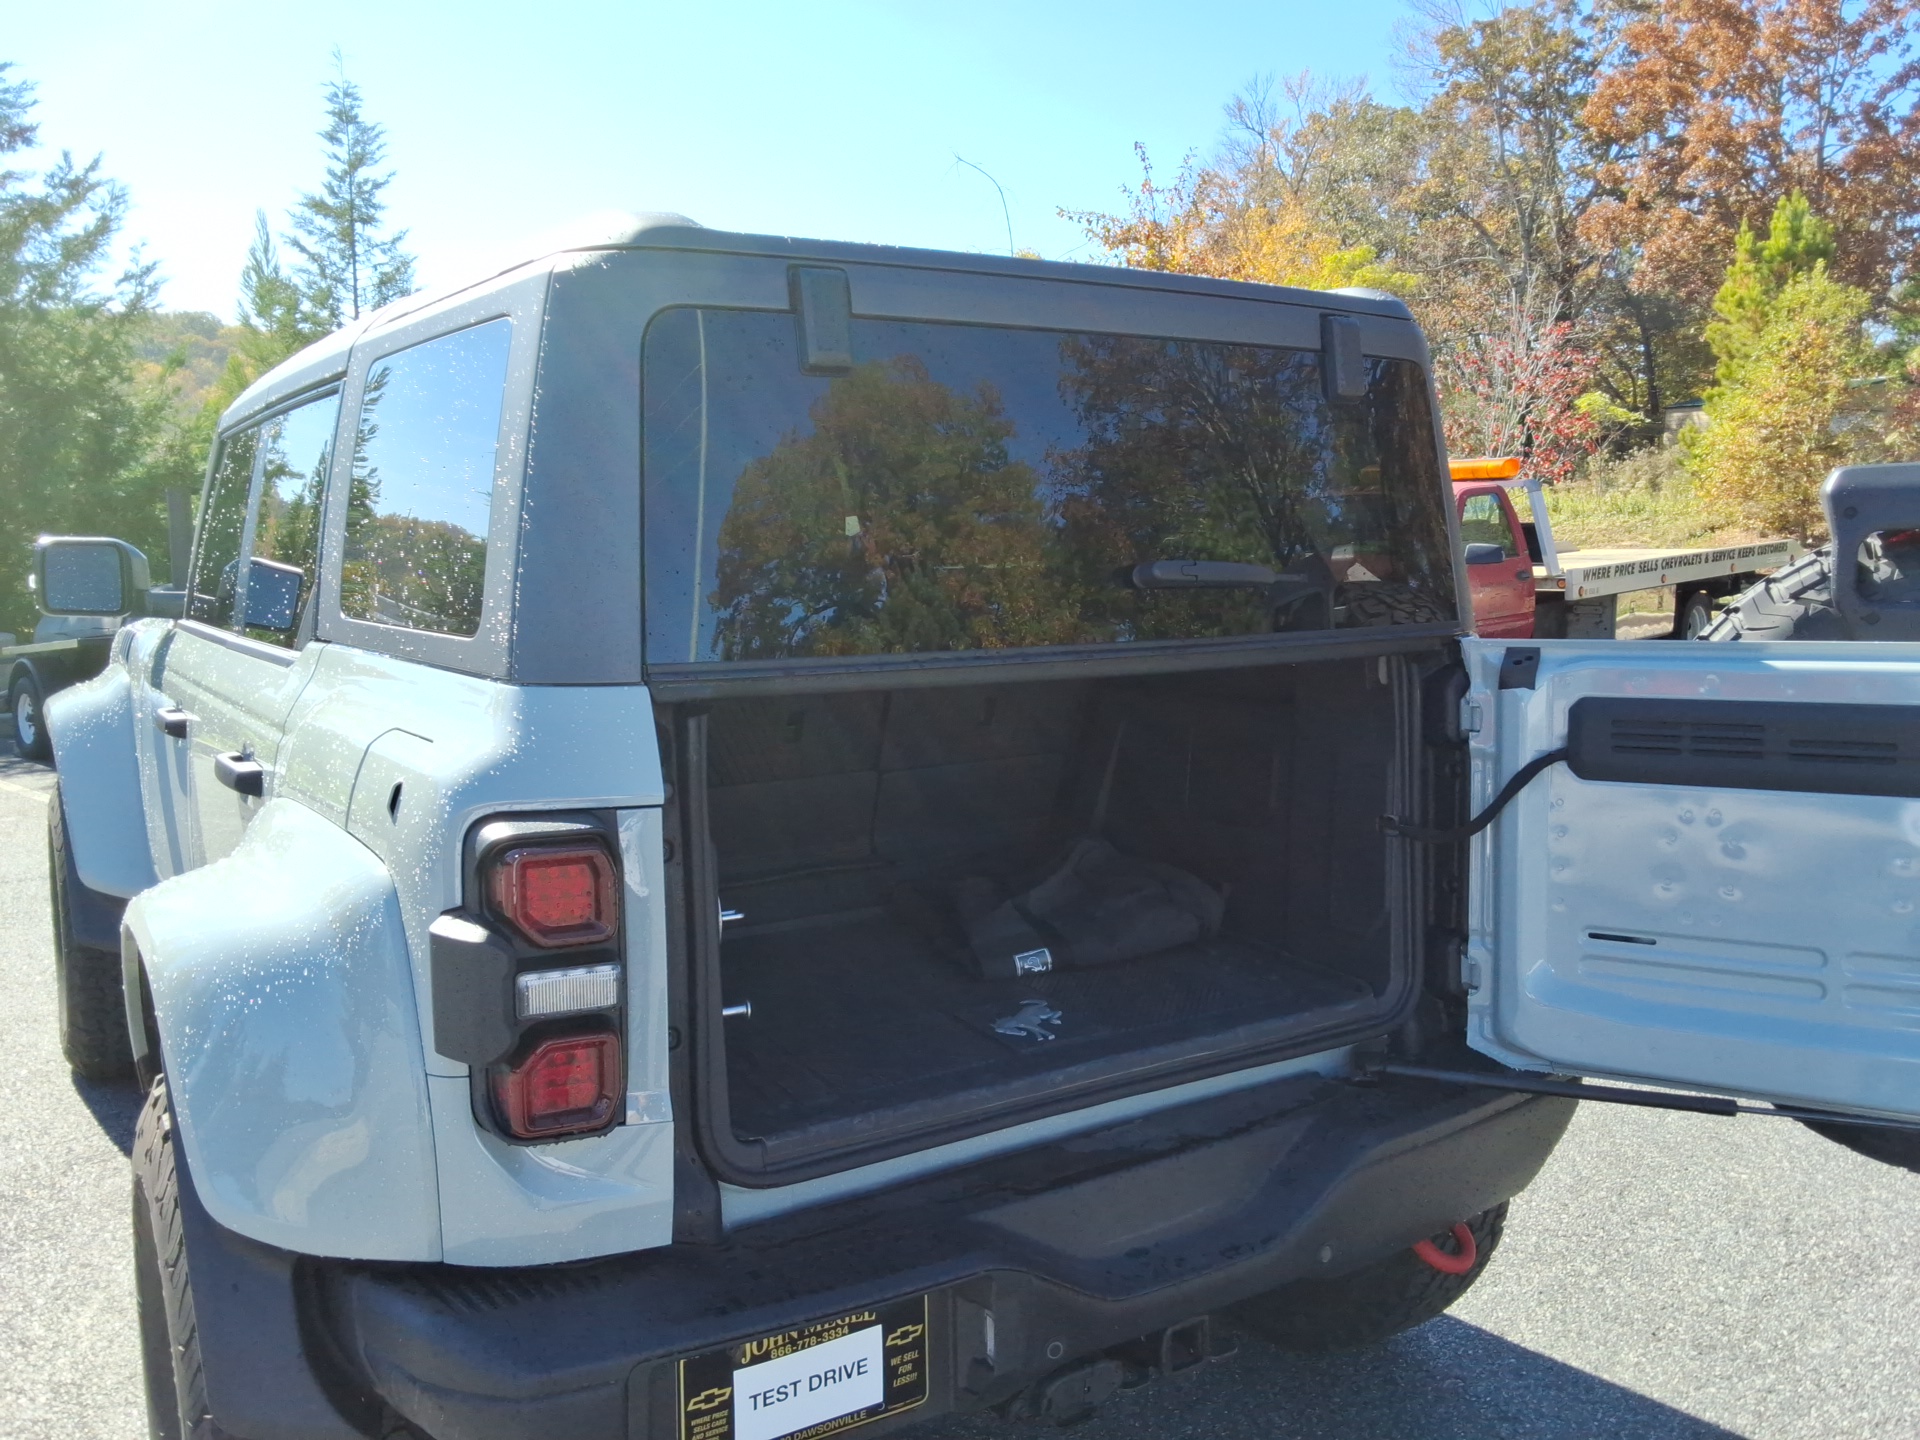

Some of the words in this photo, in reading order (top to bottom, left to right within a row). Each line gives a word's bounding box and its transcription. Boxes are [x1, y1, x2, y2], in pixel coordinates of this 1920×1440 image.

[1583, 566, 1611, 582] WHERE
[1614, 562, 1635, 577] PRICE
[1638, 559, 1659, 574] SELLS
[1661, 554, 1702, 570] CHEVROLETS
[1704, 552, 1709, 564] &
[1711, 548, 1736, 563] SERVICE
[1738, 545, 1756, 559] KEEPS
[1757, 541, 1788, 556] CUSTOMERS
[770, 1325, 849, 1360] 866-778-3334
[890, 1355, 902, 1366] WE
[903, 1349, 920, 1362] SELL
[898, 1363, 913, 1375] FOR
[748, 1379, 802, 1411] TEST
[808, 1357, 868, 1393] DRIVE
[691, 1414, 711, 1426] WHERE
[712, 1409, 729, 1420] PRICE
[693, 1422, 711, 1434] SELLS
[711, 1418, 727, 1428] CARS
[793, 1409, 867, 1440] DAWSONVILLE
[705, 1424, 729, 1438] SERVICE
